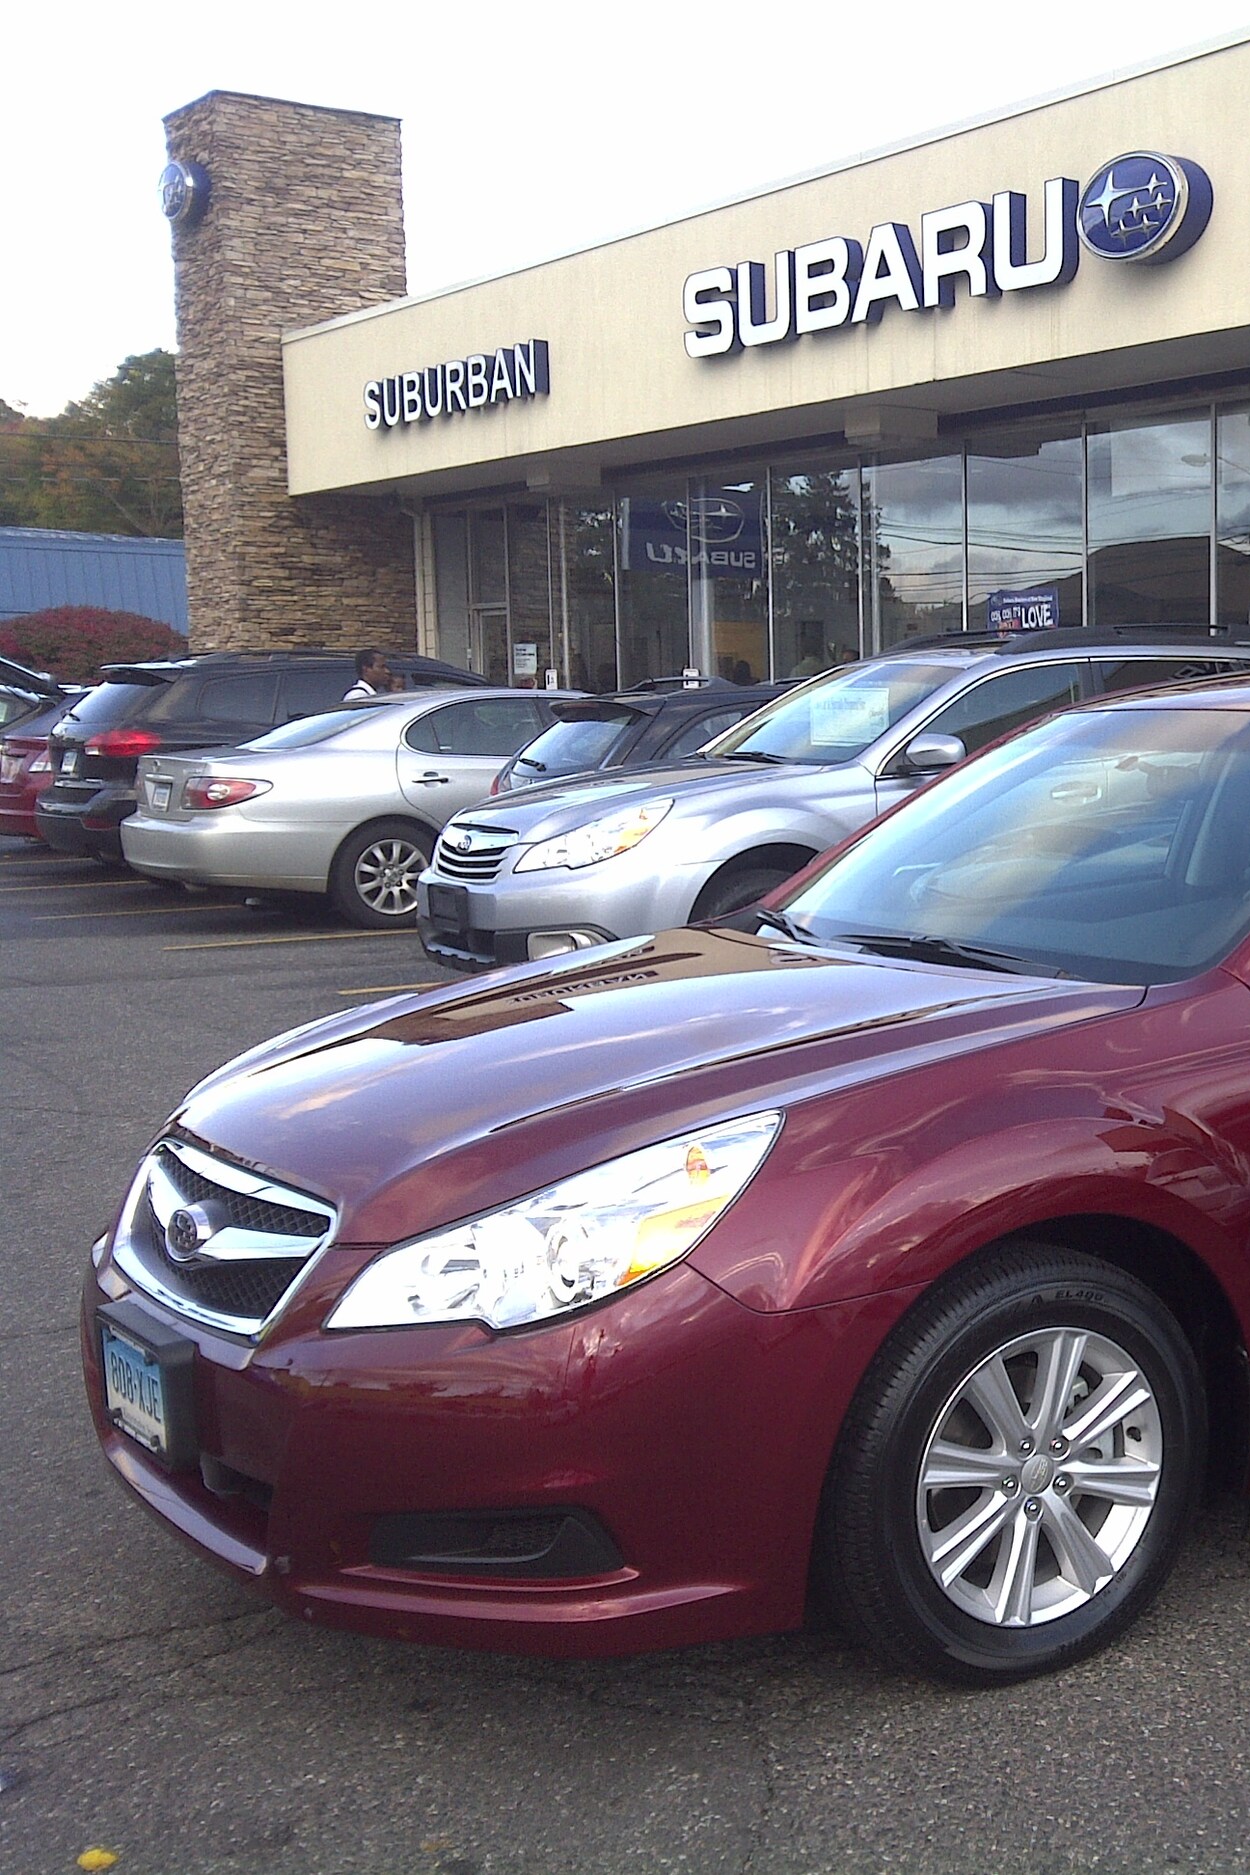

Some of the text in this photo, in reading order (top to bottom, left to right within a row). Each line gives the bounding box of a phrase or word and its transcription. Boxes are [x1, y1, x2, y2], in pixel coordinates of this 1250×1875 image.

[683, 177, 1072, 359] SUBARU
[364, 339, 543, 430] SUBURBAN
[1022, 603, 1054, 629] LOVE
